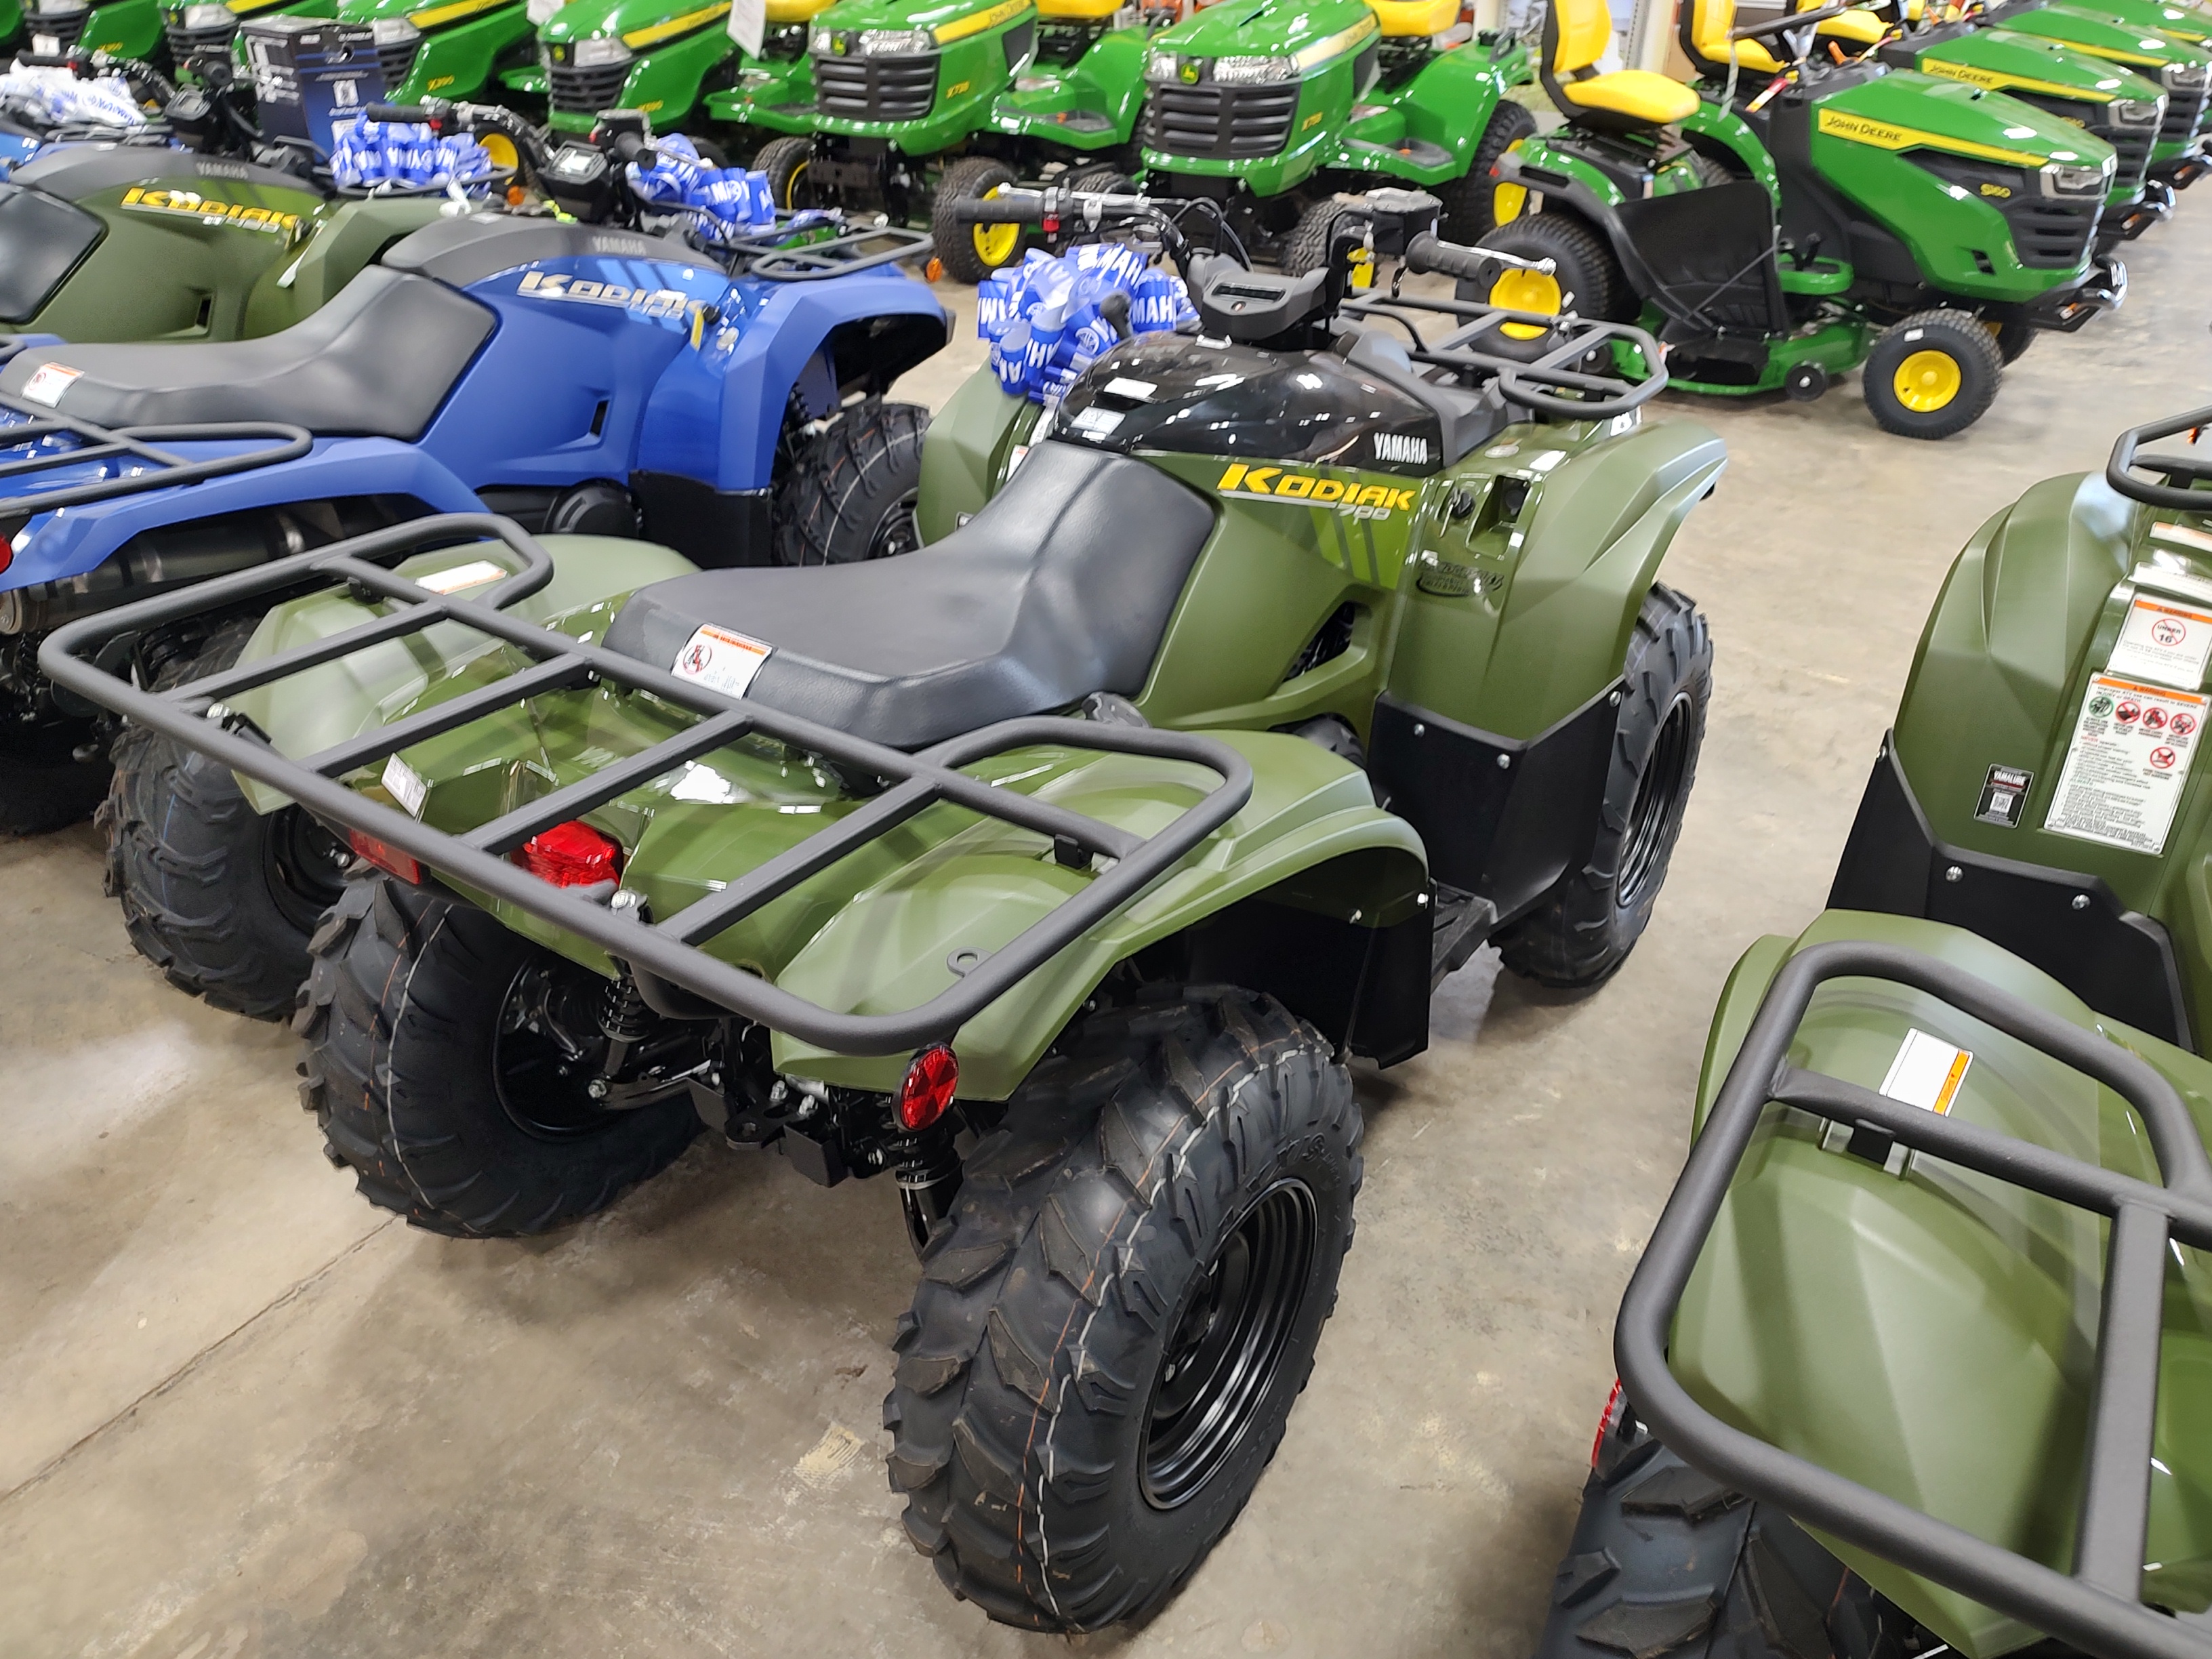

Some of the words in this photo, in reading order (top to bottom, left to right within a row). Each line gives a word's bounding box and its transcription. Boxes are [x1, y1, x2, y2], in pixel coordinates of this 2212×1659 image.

[1824, 116, 1859, 132] JOHN
[1858, 123, 1903, 142] DEERE
[592, 236, 646, 255] YAMAHA
[1373, 431, 1429, 465] YAMAHA
[1216, 462, 1416, 511] KODIAK
[2159, 634, 2173, 643] 16
